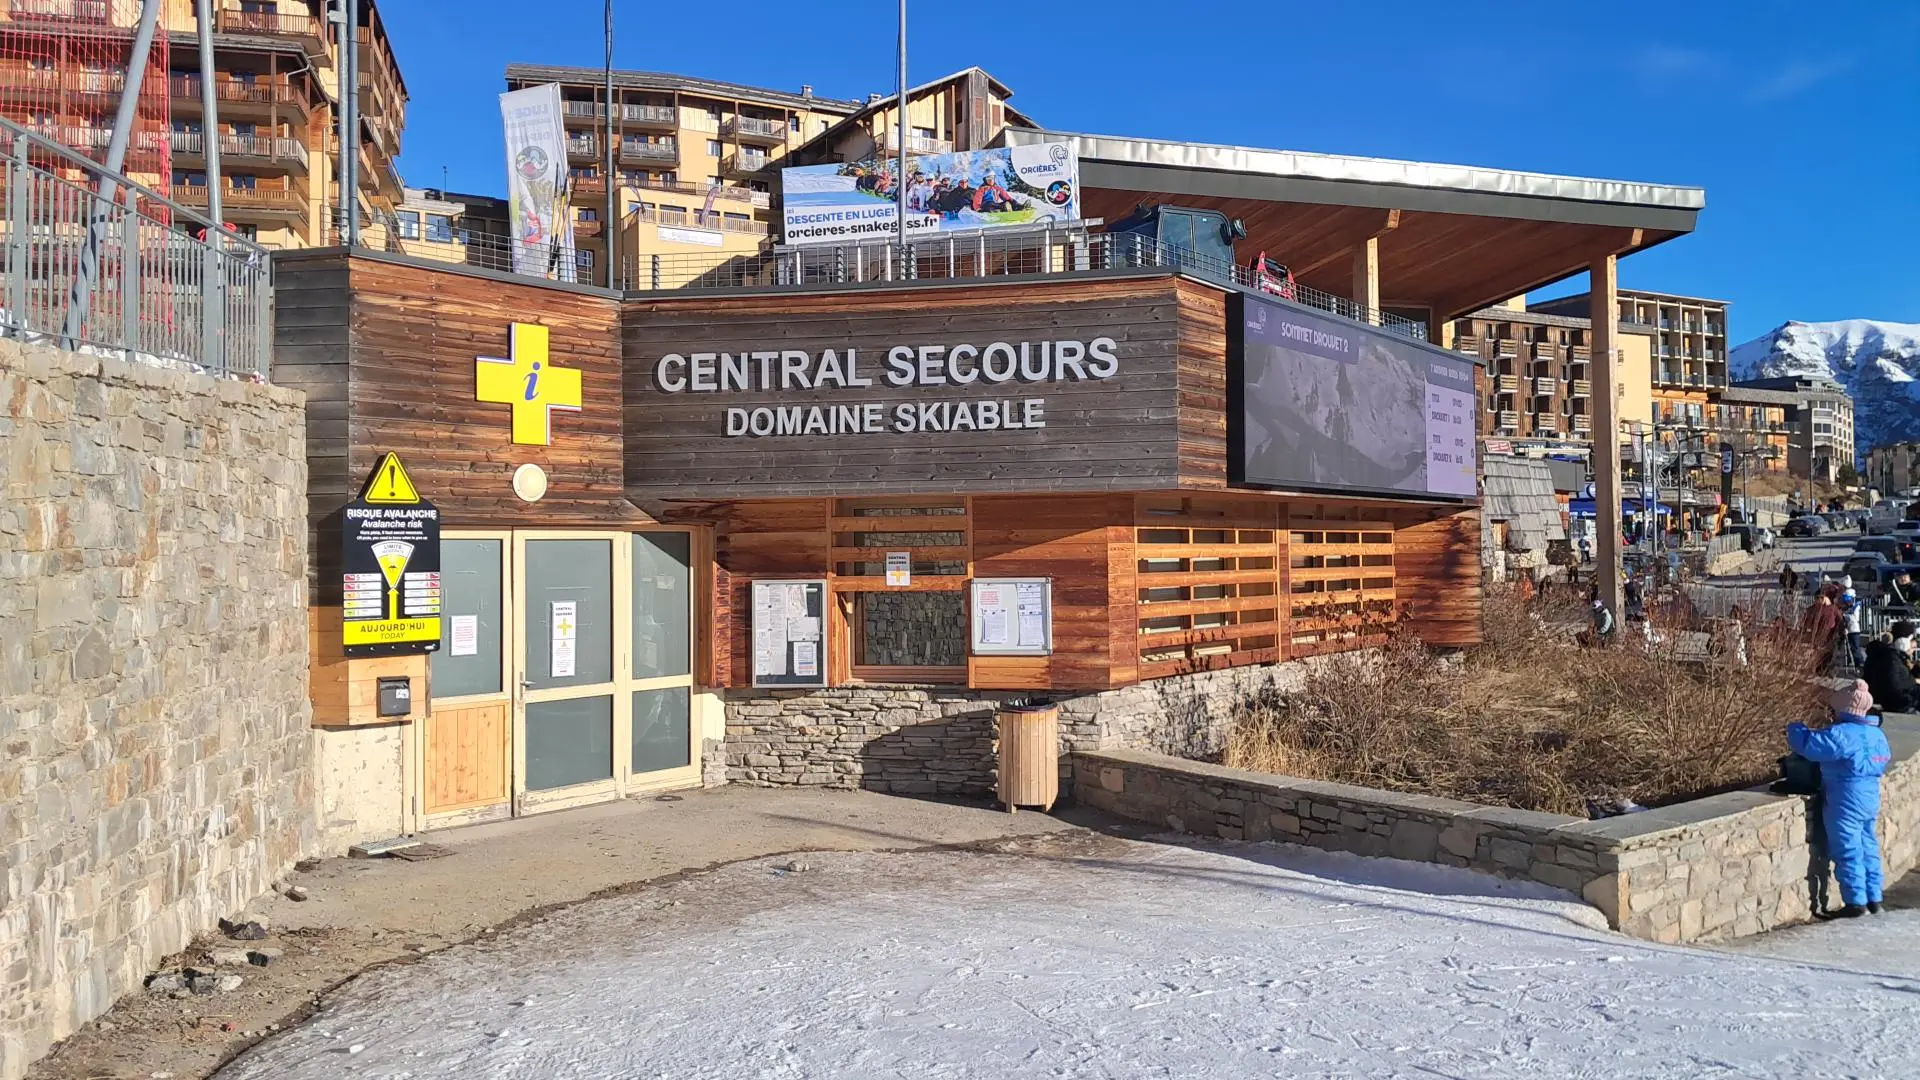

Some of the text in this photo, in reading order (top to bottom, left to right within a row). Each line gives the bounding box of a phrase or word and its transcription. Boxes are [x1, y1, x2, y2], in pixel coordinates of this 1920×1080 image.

[1021, 164, 1057, 174] ORCIÈRES
[787, 208, 895, 225] DESCENTE EN LUGE!
[788, 216, 937, 239] orcieres-snakegss.fr
[1281, 322, 1349, 353] SOMMET DROUVET 2
[657, 337, 1119, 392] CENTRAL SECOURS
[726, 398, 1046, 437] DOMAINE SKIABLE
[347, 508, 437, 519] RISQUE AVALANCHE
[361, 520, 423, 528] Avalanche risk
[360, 622, 425, 633] AUJOURD'HUI
[381, 632, 406, 640] TODAY
